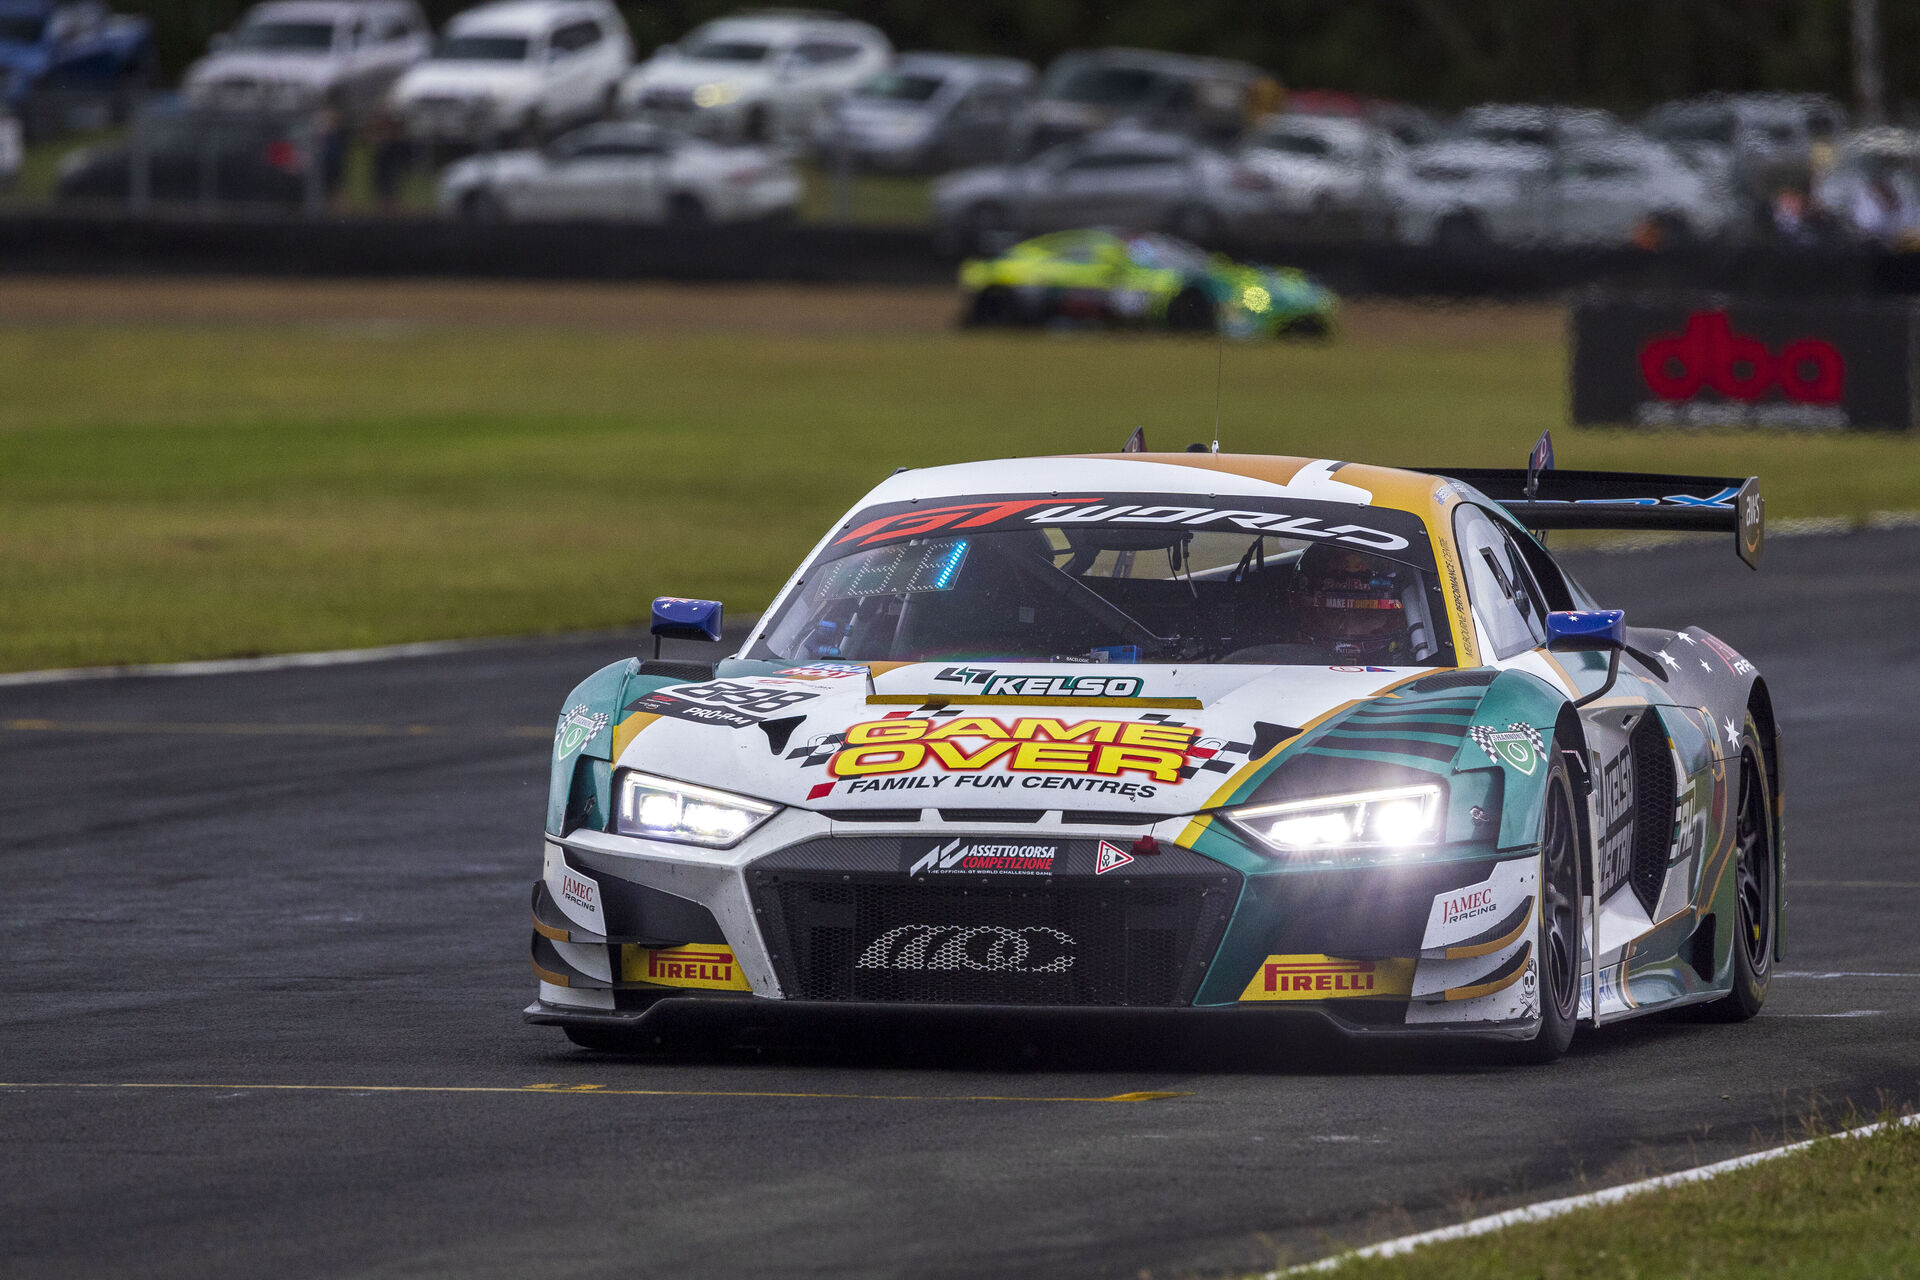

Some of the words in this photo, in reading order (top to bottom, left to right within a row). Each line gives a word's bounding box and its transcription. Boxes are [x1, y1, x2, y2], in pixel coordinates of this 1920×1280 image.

[1640, 310, 1845, 405] dba
[1745, 493, 1760, 527] aws
[1024, 505, 1410, 551] WORLD
[1445, 561, 1465, 614] PERFORMANCE
[1326, 599, 1346, 608] MAKE
[1346, 599, 1354, 608] IT
[1456, 612, 1474, 659] MELBOURNE
[671, 681, 821, 713] 888
[984, 676, 1142, 697] KELSO
[683, 706, 753, 726] PRO-AM
[846, 717, 1204, 746] GAME
[833, 740, 1188, 783] OVER
[847, 775, 951, 794] FAMILY
[953, 774, 1015, 789] FUN
[1020, 776, 1158, 799] CENTRES
[1605, 754, 1633, 828] KELSO
[962, 857, 1054, 870] COMPETIZIONE
[968, 845, 1018, 857] ASSETTO
[1018, 846, 1056, 858] CORSA
[1101, 847, 1111, 867] TOW
[562, 875, 594, 902] JAMEC
[564, 893, 596, 913] RACING
[1442, 888, 1493, 925] JAMEC
[1449, 903, 1498, 924] RACING
[649, 950, 734, 982] PIRELLI
[1264, 961, 1378, 992] PIRELLI
